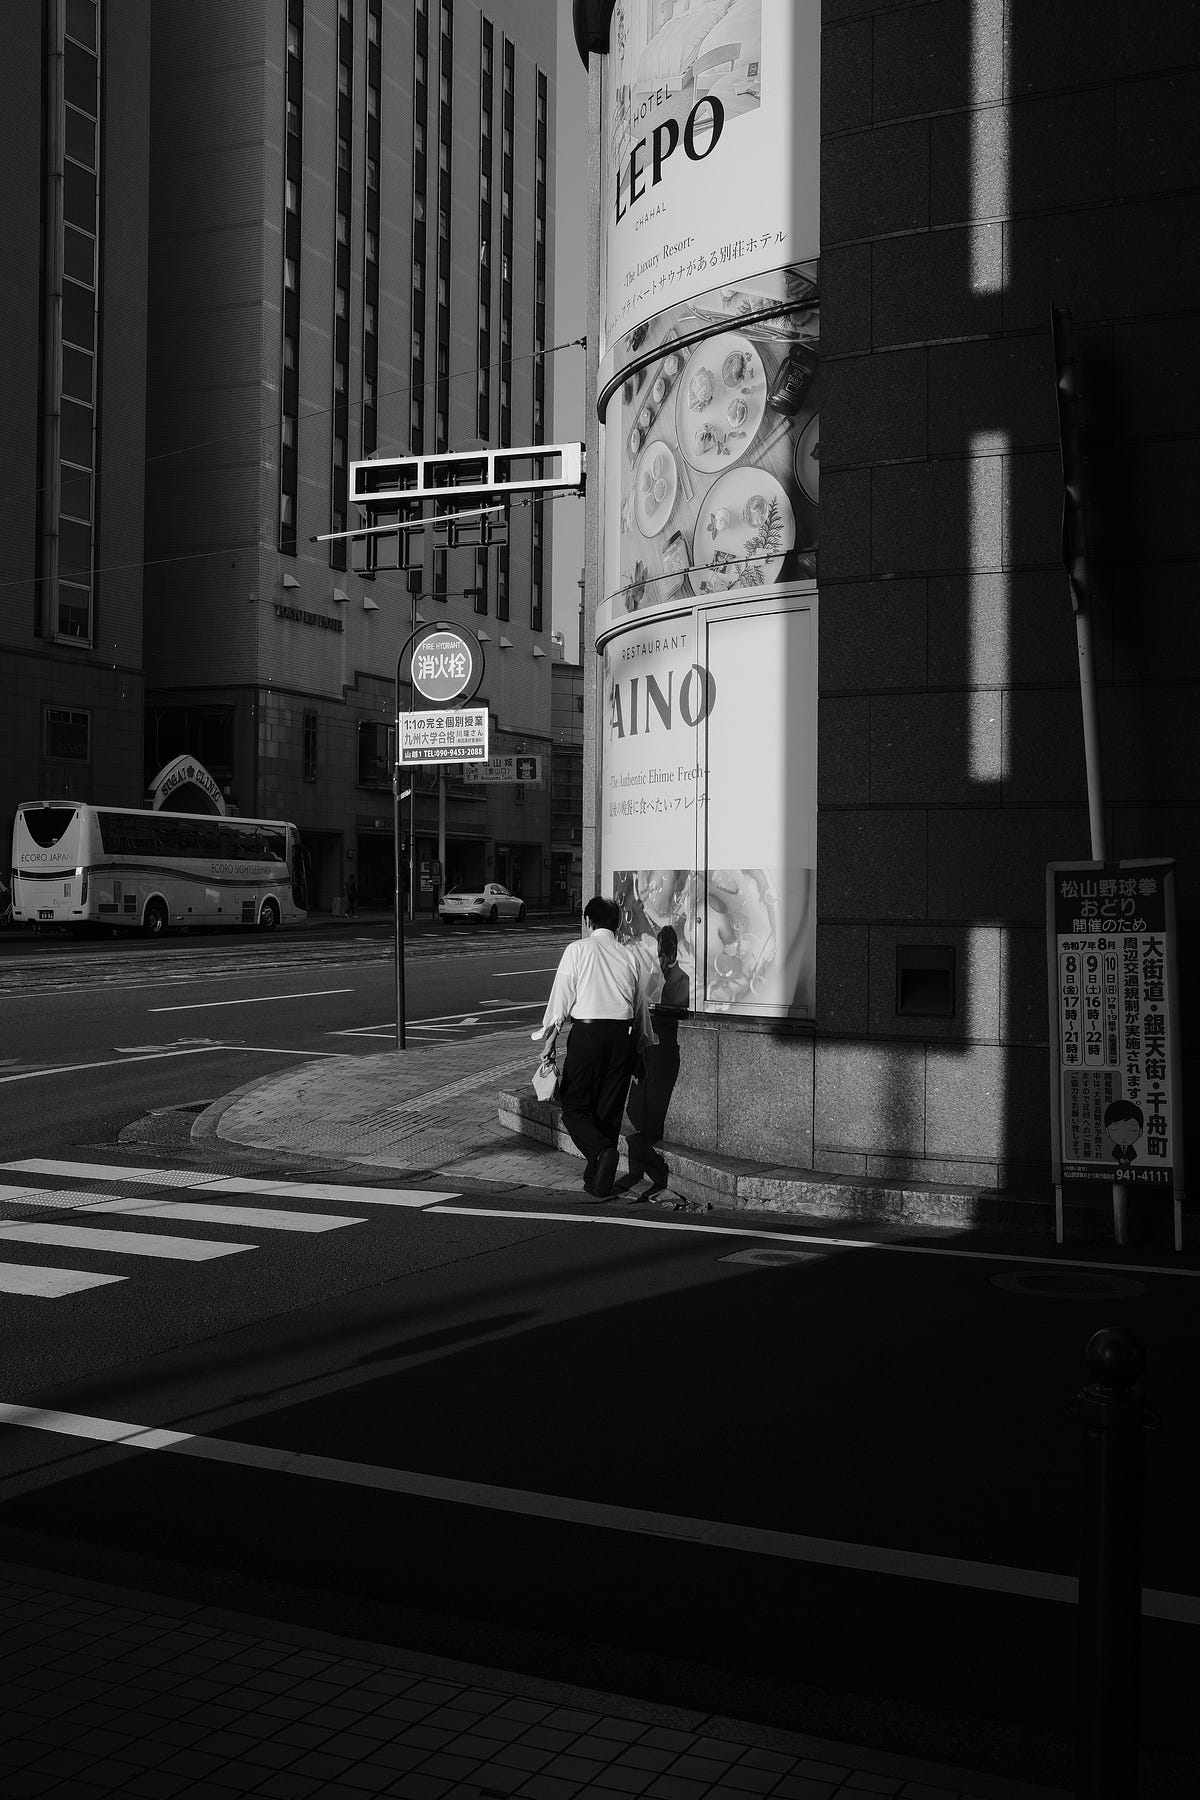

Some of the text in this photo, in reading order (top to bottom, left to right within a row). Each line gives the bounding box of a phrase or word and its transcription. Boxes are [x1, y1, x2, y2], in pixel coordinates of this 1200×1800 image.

[633, 84, 672, 128] HOTEL
[615, 95, 725, 226] LEPO
[634, 202, 667, 231] CHAHAL
[637, 253, 660, 278] Luxury
[436, 641, 461, 650] HYDRANT
[622, 634, 687, 661] RESTAURANT
[418, 652, 467, 680] 消火栓
[609, 663, 717, 741] AINO
[404, 715, 484, 731] 1:1の完全個別授業
[404, 730, 455, 746] 九州大学合格
[162, 767, 221, 802] SUGAI CLINIC
[648, 768, 674, 784] Ehime
[21, 854, 73, 862] ECORO JAPAN
[211, 863, 271, 876] ECORO SIGHTSEEING
[1060, 878, 1158, 899] 松山野球拳
[1080, 898, 1136, 917] おどり
[1072, 917, 1148, 933] 開催のため
[1061, 937, 1116, 951] 令和7年8月
[1122, 937, 1142, 1106] 周辺交通規制が実施されます。
[1142, 936, 1169, 1158] 大街道・銀天街・千舟町
[1116, 1169, 1169, 1182] 941-4111
